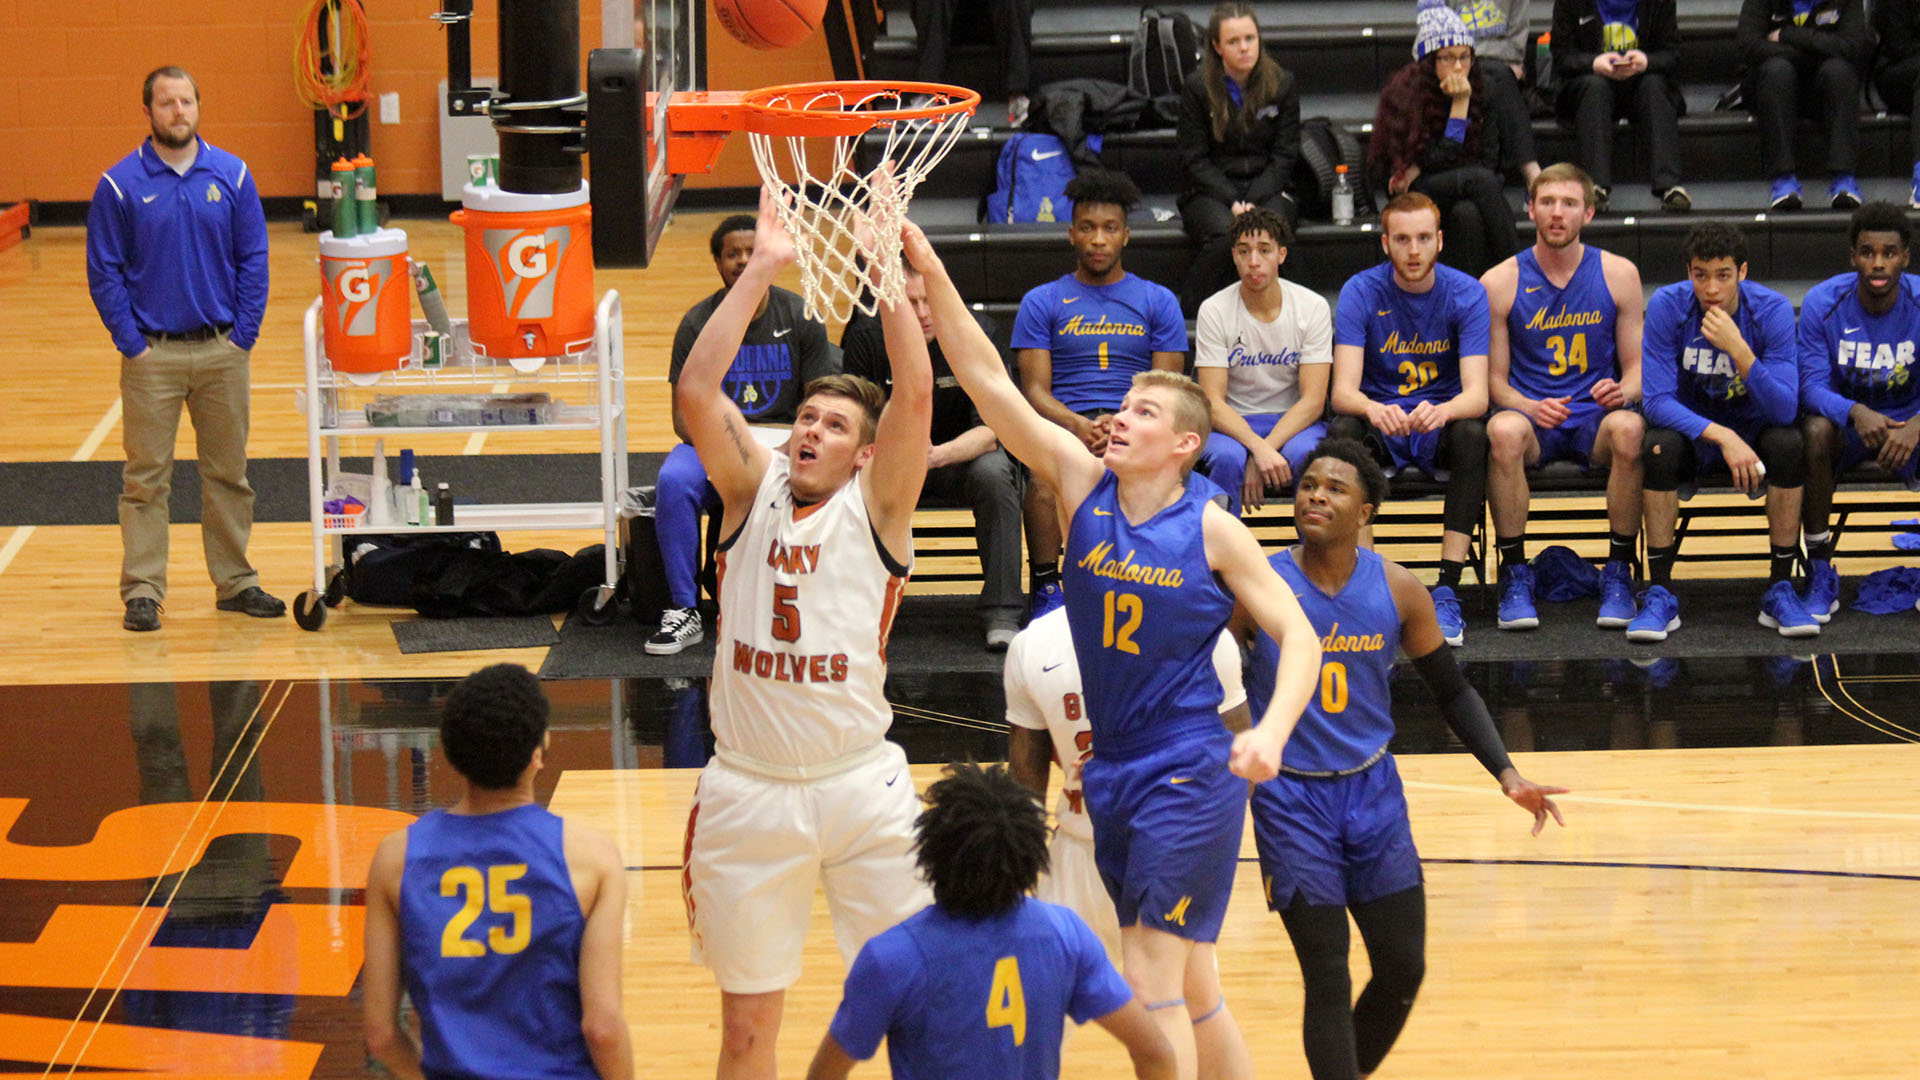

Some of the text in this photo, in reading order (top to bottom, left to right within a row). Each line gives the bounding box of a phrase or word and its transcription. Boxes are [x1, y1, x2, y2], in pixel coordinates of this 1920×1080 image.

[508, 234, 547, 279] G
[340, 268, 371, 302] G
[1059, 314, 1147, 337] Madonna
[1525, 303, 1603, 330] Madonna
[1098, 341, 1109, 370] 1
[1379, 330, 1450, 355] Madonna
[1545, 333, 1588, 377] 34
[1682, 346, 1738, 378] FEA
[1838, 340, 1916, 370] FEAR
[1398, 360, 1439, 396] 30
[1078, 540, 1184, 588] Madonna
[771, 582, 801, 644] 5
[1103, 590, 1144, 655] 12
[1319, 622, 1385, 652] donna
[733, 639, 849, 683] WOLVES
[1321, 661, 1349, 714] 0
[440, 863, 532, 958] 25
[985, 955, 1027, 1048] 4
